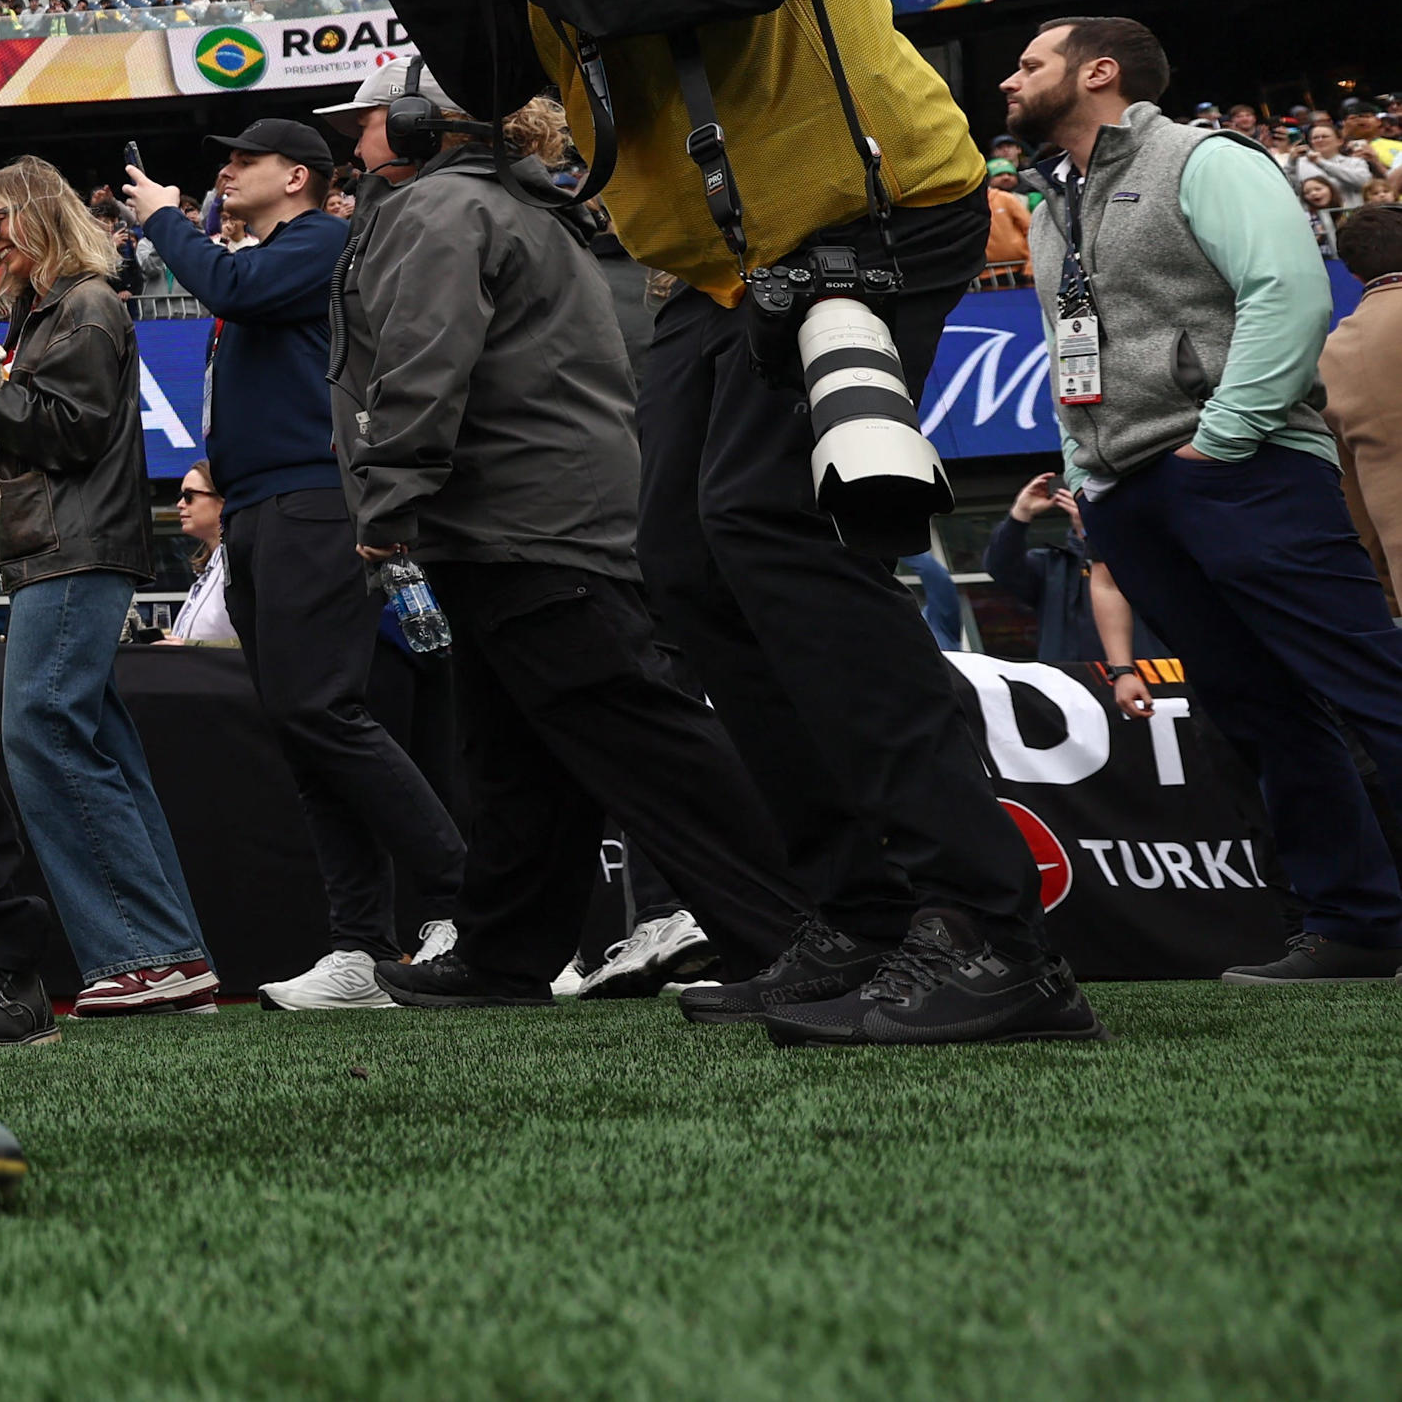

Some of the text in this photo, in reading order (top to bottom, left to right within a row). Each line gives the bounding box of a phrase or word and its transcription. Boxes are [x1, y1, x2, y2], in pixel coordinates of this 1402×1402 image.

[283, 18, 412, 58] ROAD
[285, 60, 368, 75] PRESENTED BY
[707, 172, 723, 186] PRO
